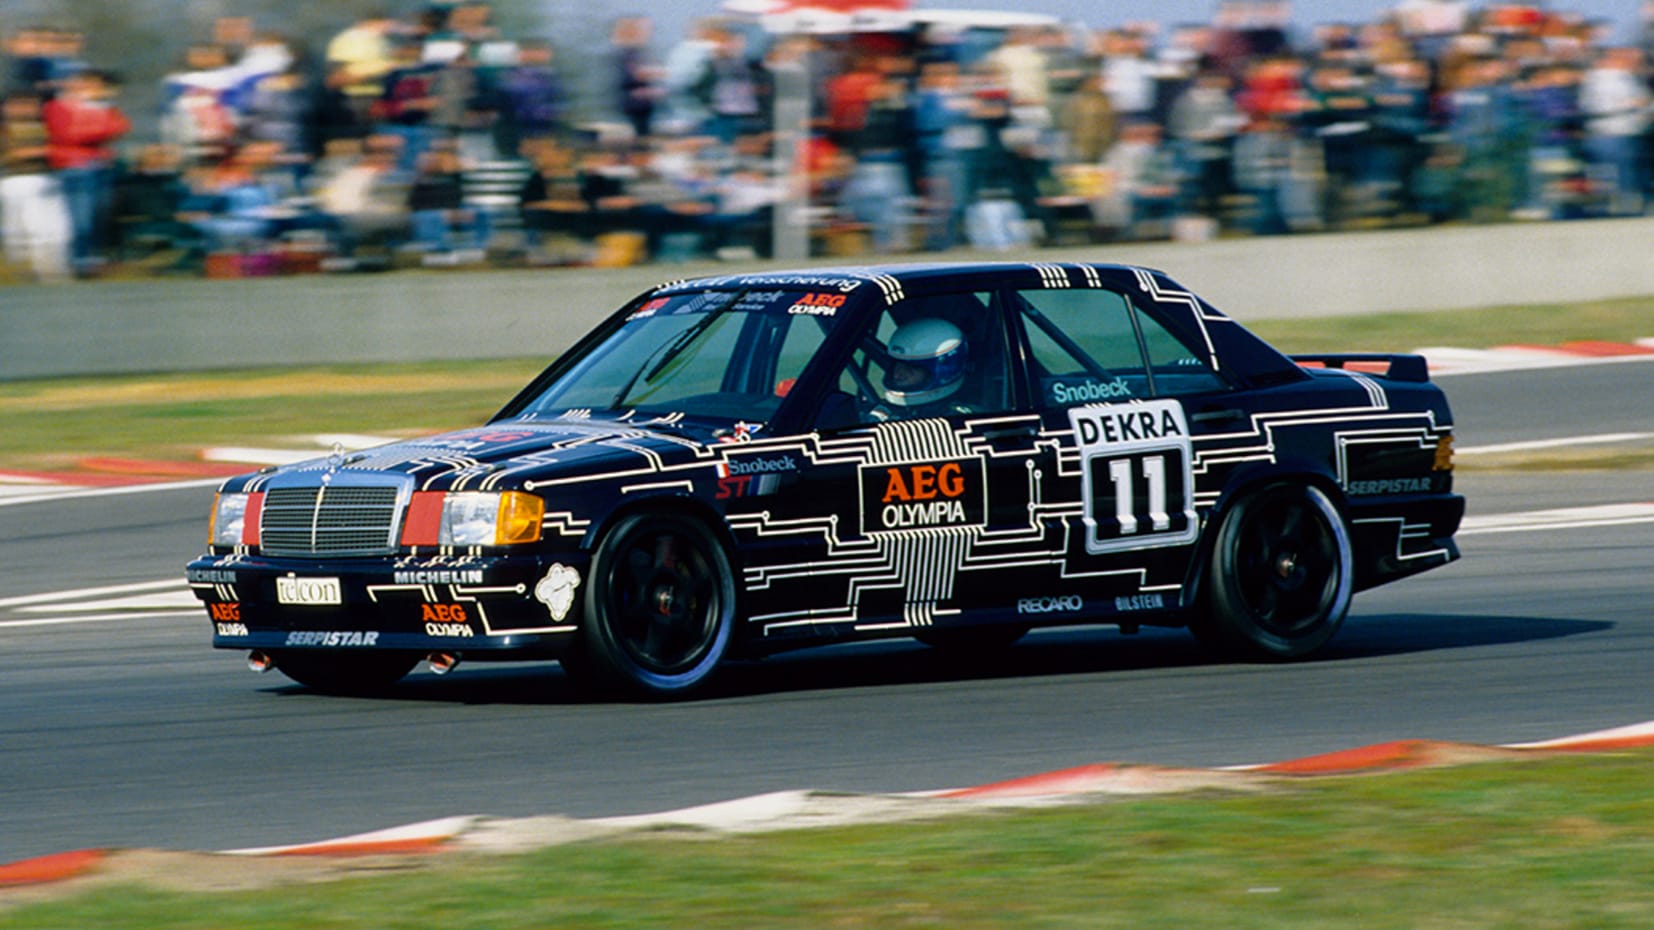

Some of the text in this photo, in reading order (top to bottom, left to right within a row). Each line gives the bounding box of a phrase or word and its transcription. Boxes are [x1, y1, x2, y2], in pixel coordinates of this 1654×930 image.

[794, 293, 846, 307] AEG
[1053, 383, 1131, 403] Snobeck
[1077, 409, 1182, 446] DEKRA
[728, 455, 796, 475] Snobeck
[882, 463, 964, 502] AEG
[1349, 478, 1431, 495] SERPISTAR
[1109, 455, 1170, 534] 11
[882, 500, 966, 528] OLYMPIA
[394, 570, 483, 584] MICHELIN
[1018, 595, 1083, 613] RECARO
[1115, 594, 1164, 611] BILSTEIN
[210, 603, 241, 621] AEG
[421, 604, 467, 622] AEG
[285, 631, 379, 646] SERPISTAR
[425, 623, 474, 637] OLYMPIA
